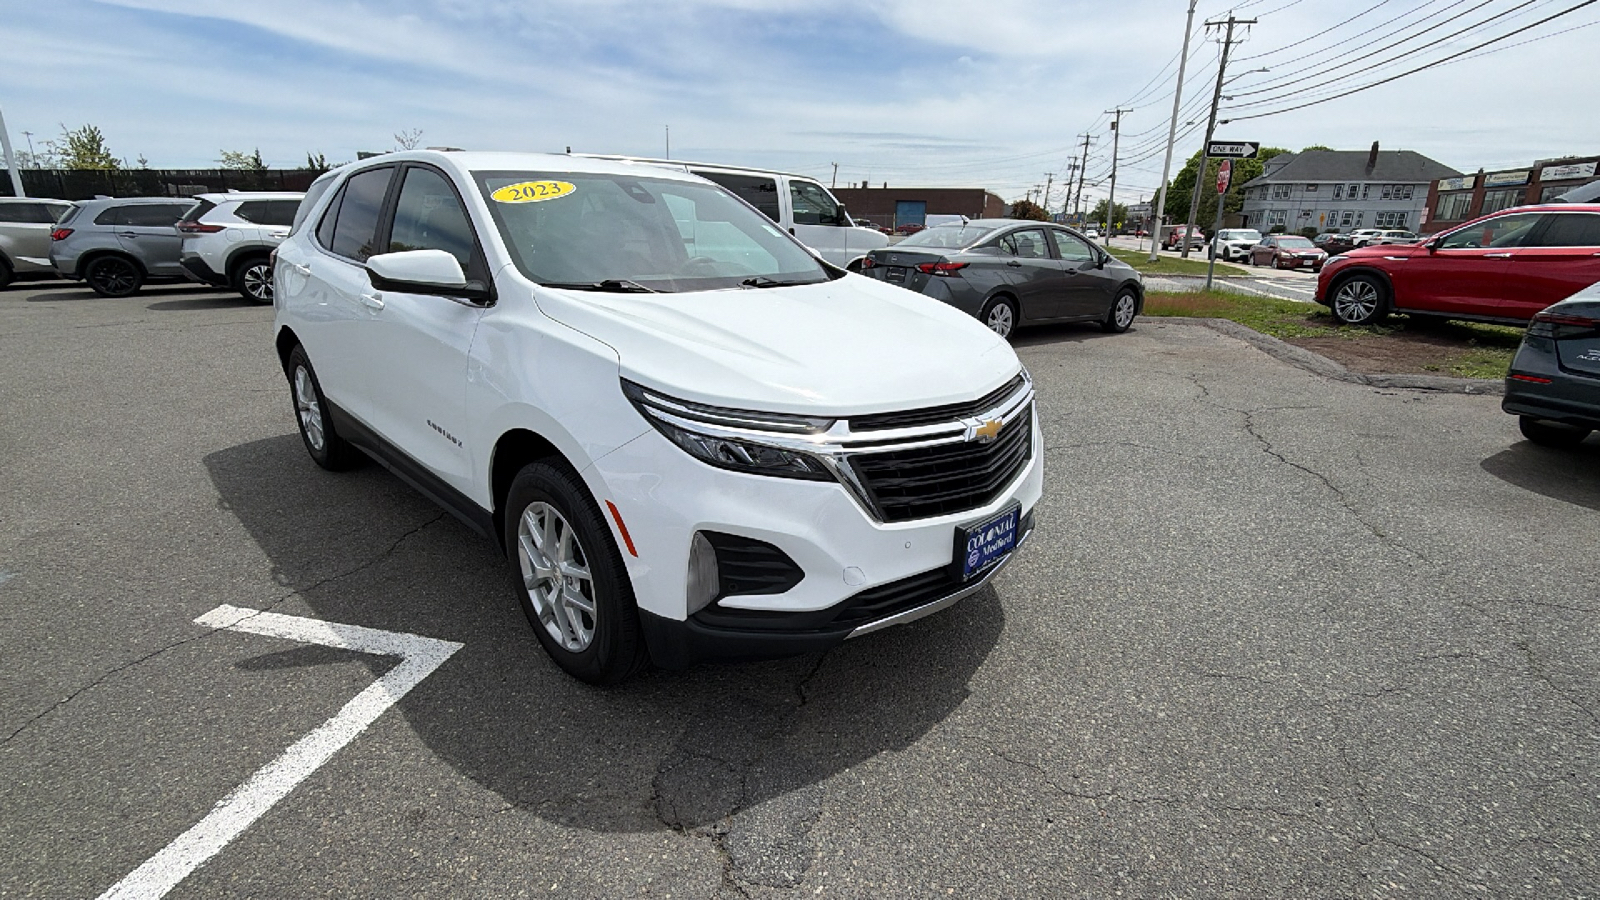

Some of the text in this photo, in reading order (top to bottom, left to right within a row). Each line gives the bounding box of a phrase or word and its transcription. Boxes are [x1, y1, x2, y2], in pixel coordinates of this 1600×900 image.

[1212, 145, 1227, 153] ONE
[1218, 170, 1230, 184] STOP
[508, 182, 562, 201] 2023
[967, 515, 1016, 552] COLONIAL
[982, 532, 1013, 557] Medford
